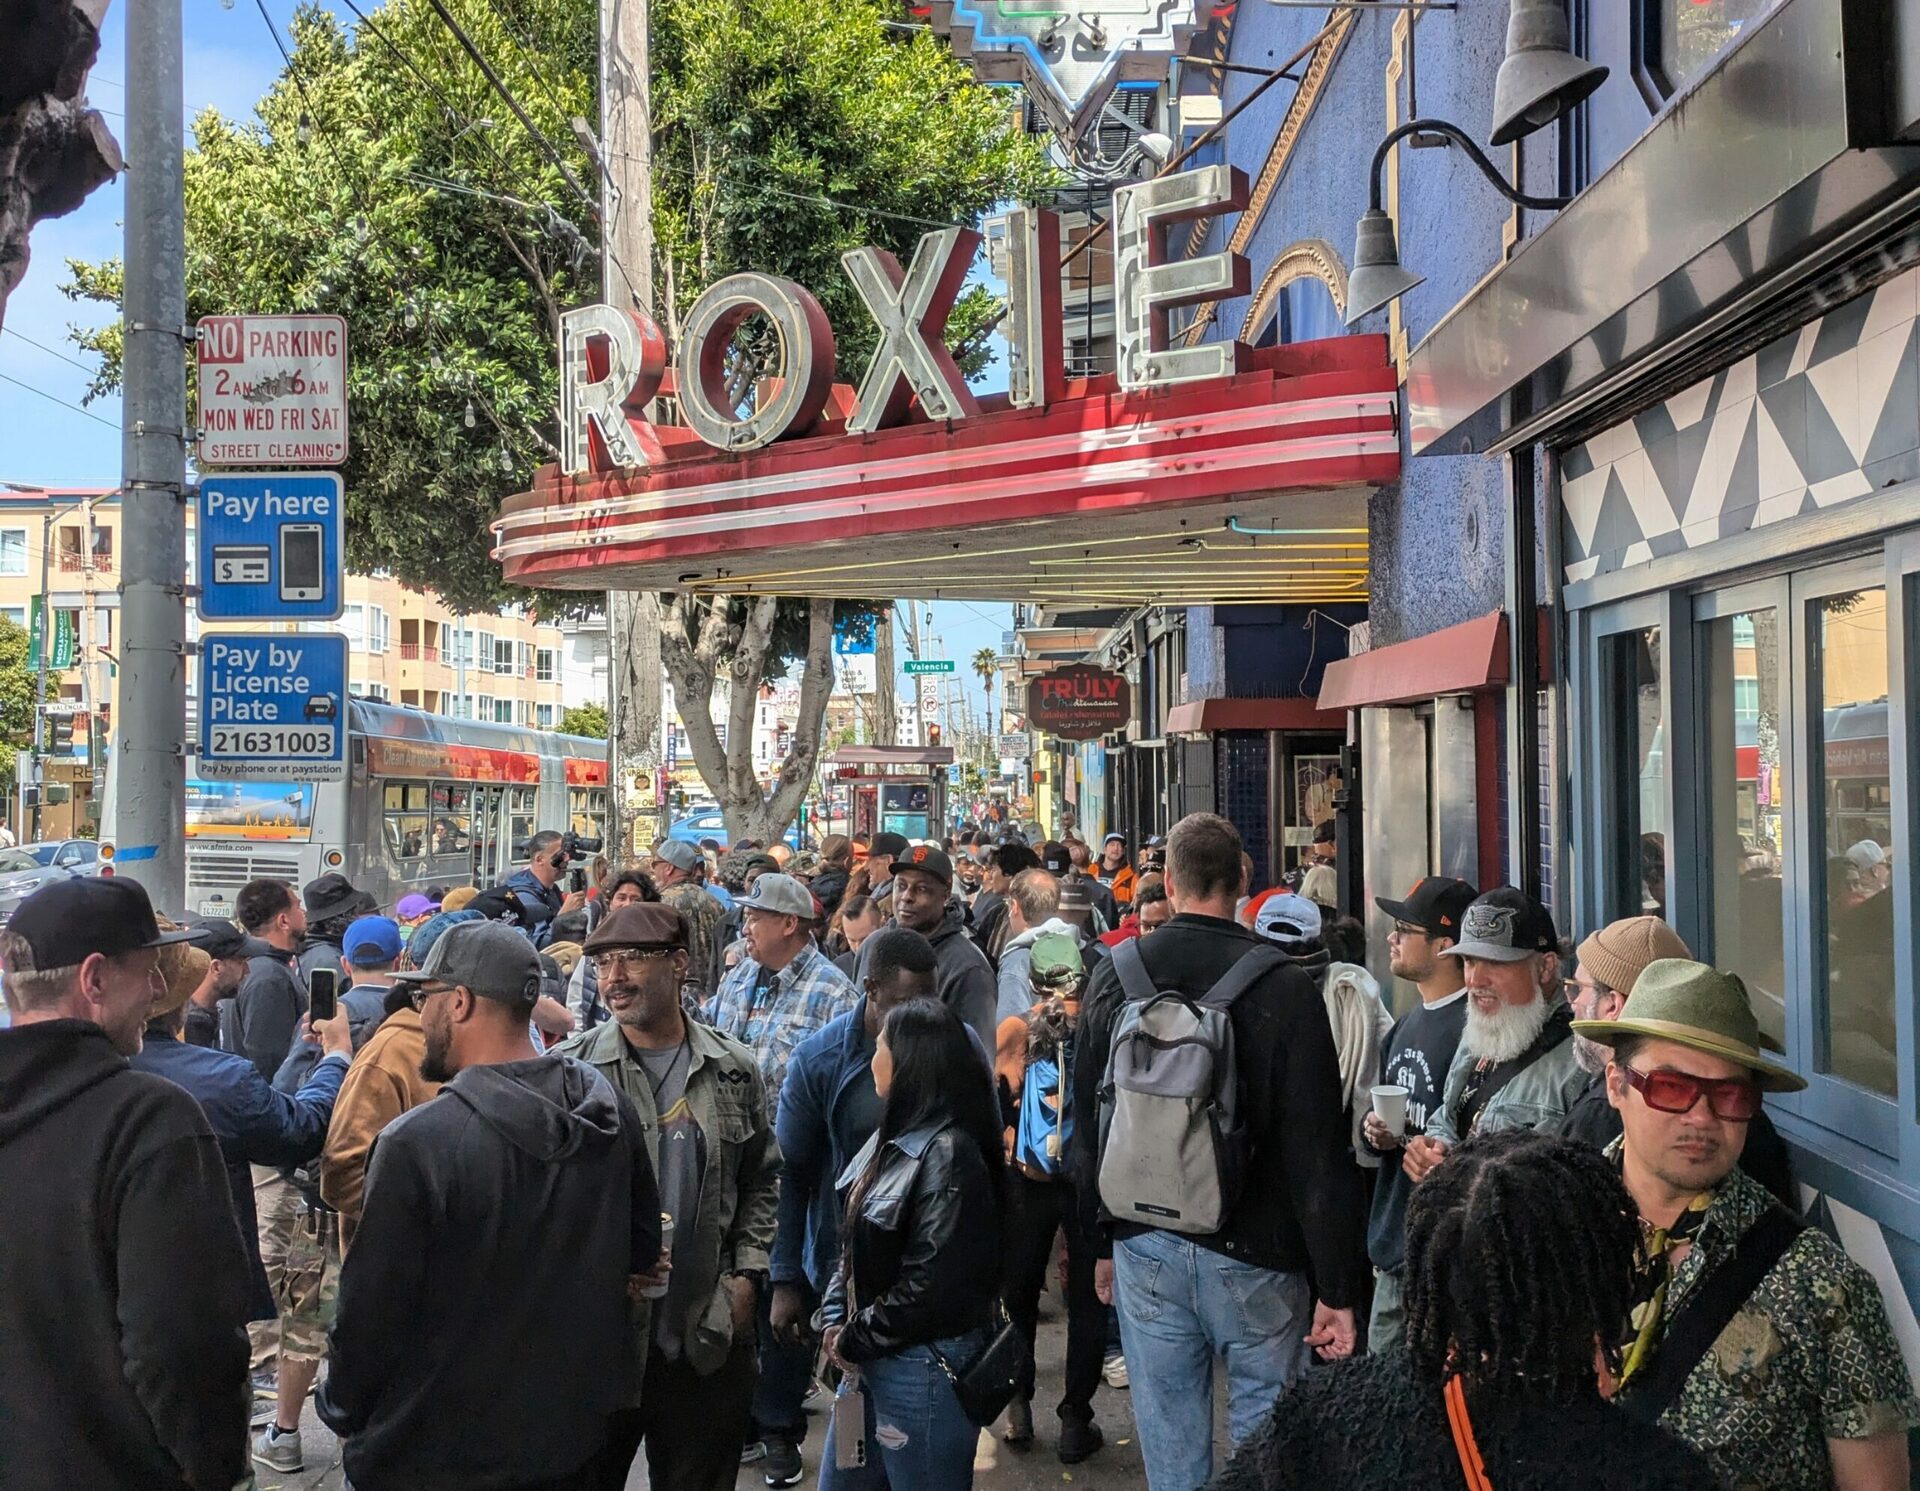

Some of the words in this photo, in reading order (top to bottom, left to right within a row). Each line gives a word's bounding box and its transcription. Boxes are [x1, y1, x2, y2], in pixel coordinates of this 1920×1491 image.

[558, 164, 1250, 477] ROXIE
[204, 322, 238, 359] NO
[250, 330, 337, 357] PARKING
[205, 408, 236, 431] MON
[243, 408, 274, 430] WED
[281, 408, 305, 430] FRI
[311, 408, 339, 430] SAT
[211, 444, 260, 458] STREET
[269, 443, 334, 458] CLEANING
[207, 491, 259, 523] Pay
[264, 489, 330, 516] here
[212, 643, 260, 673] Pay
[269, 643, 303, 673] by
[911, 663, 949, 671] Valencia
[212, 670, 310, 694] License
[923, 685, 937, 694] 20
[1038, 673, 1121, 699] TRÜLY
[211, 696, 278, 720] Plate
[213, 732, 331, 753] 21631003
[201, 764, 219, 775] Pay
[221, 763, 232, 775] by
[235, 763, 265, 775] phone
[268, 765, 277, 774] or
[280, 764, 290, 774] at
[292, 764, 342, 776] paystation
[189, 843, 253, 852] www.sfmta.com
